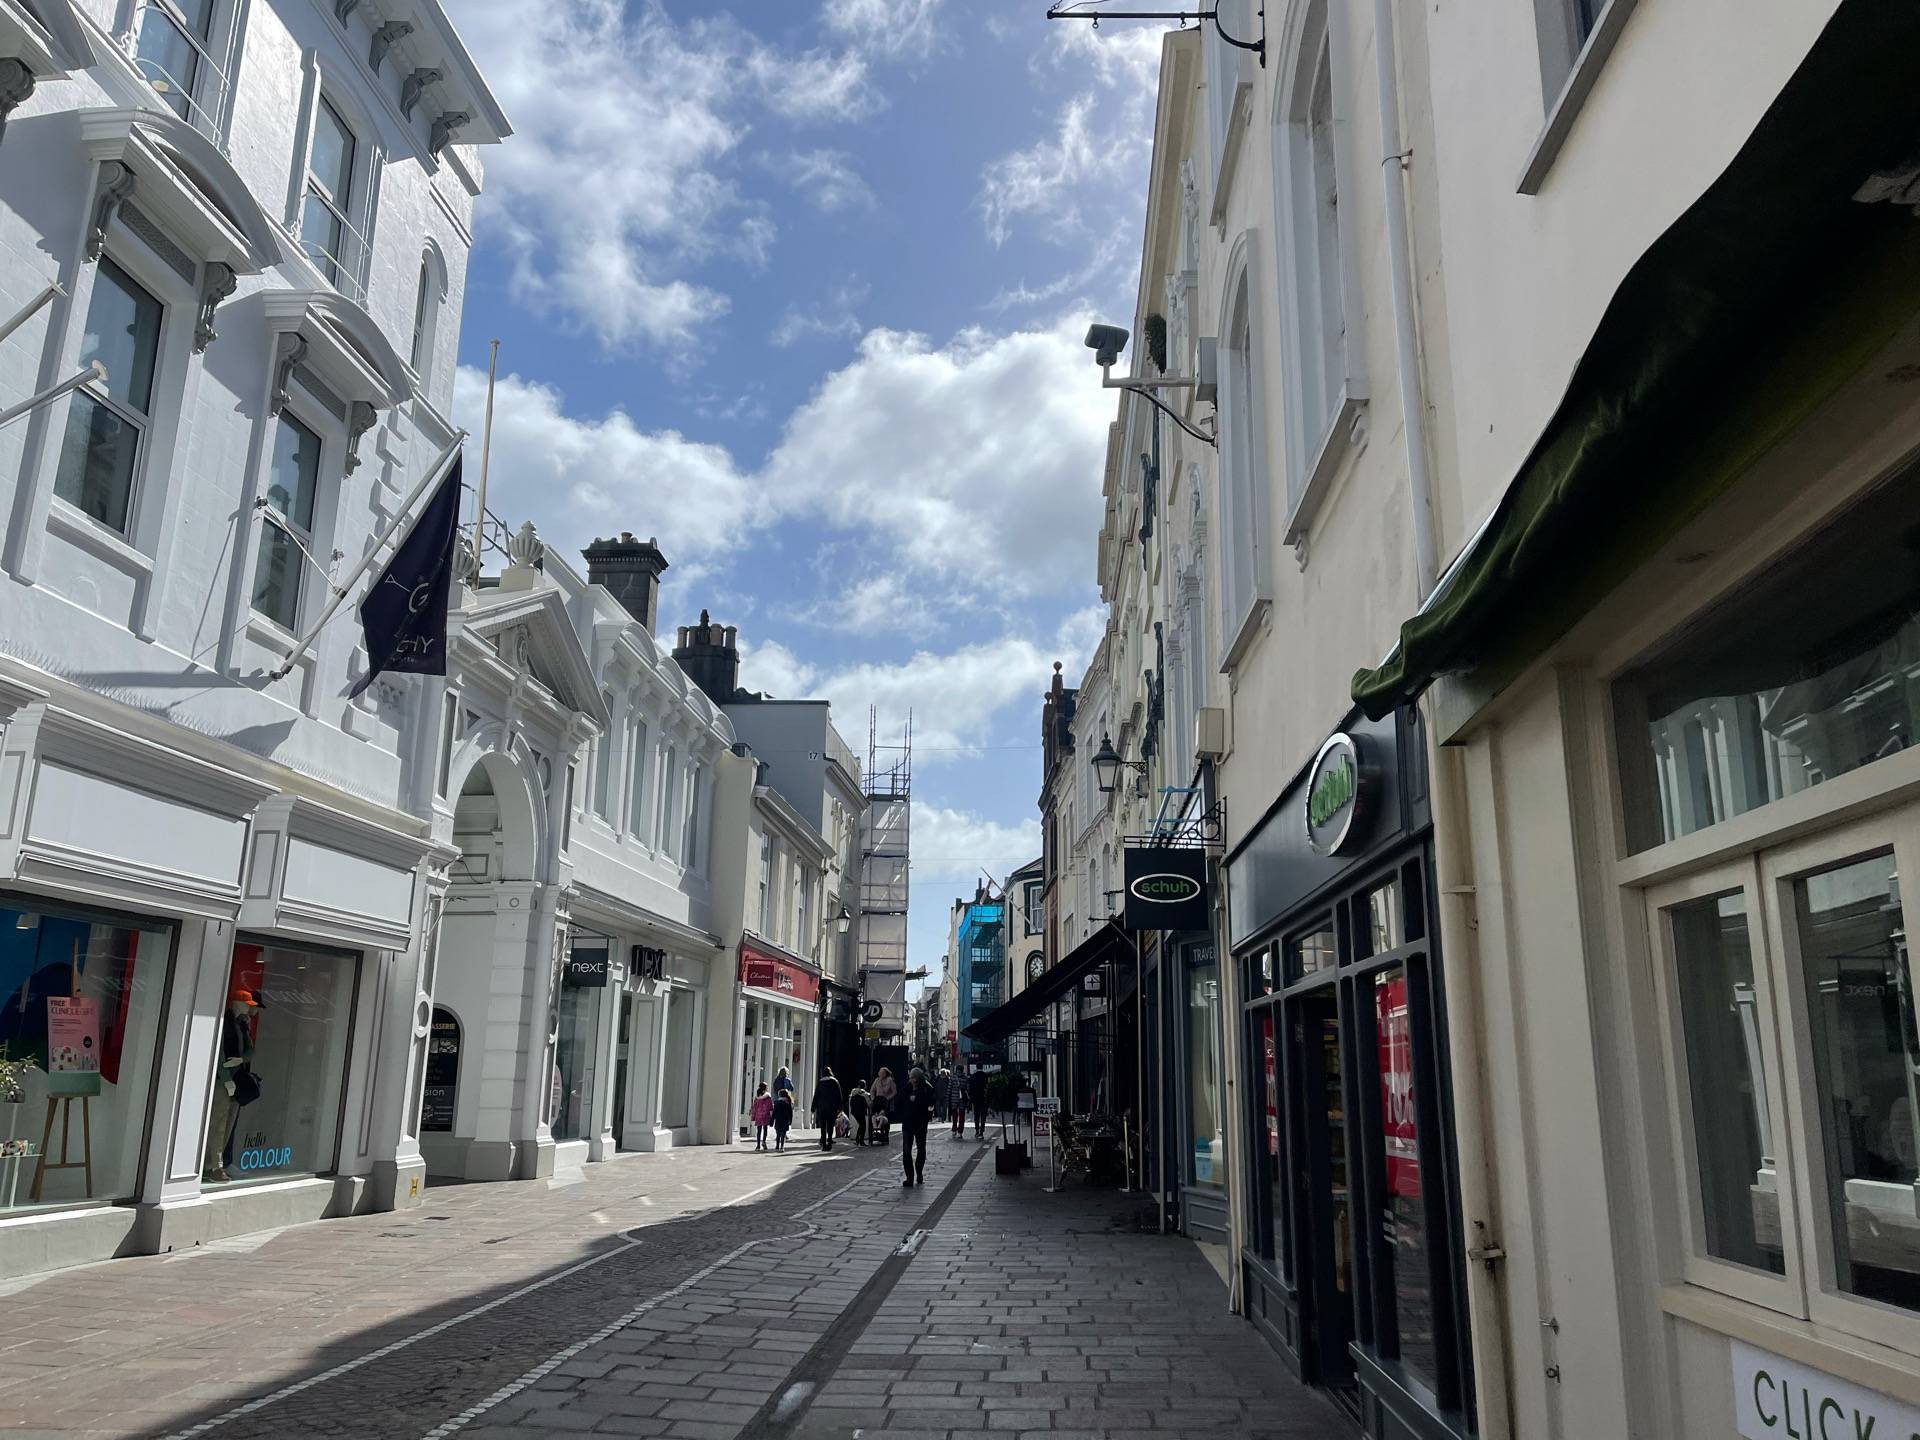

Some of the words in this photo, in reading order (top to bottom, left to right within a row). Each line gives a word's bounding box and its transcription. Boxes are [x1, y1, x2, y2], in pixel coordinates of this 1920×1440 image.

[1141, 881, 1190, 893] schuh
[1193, 947, 1216, 962] TRAVE
[571, 962, 604, 973] next
[864, 1005, 880, 1016] JD
[243, 1131, 267, 1149] hello
[240, 1147, 292, 1170] COLOUR
